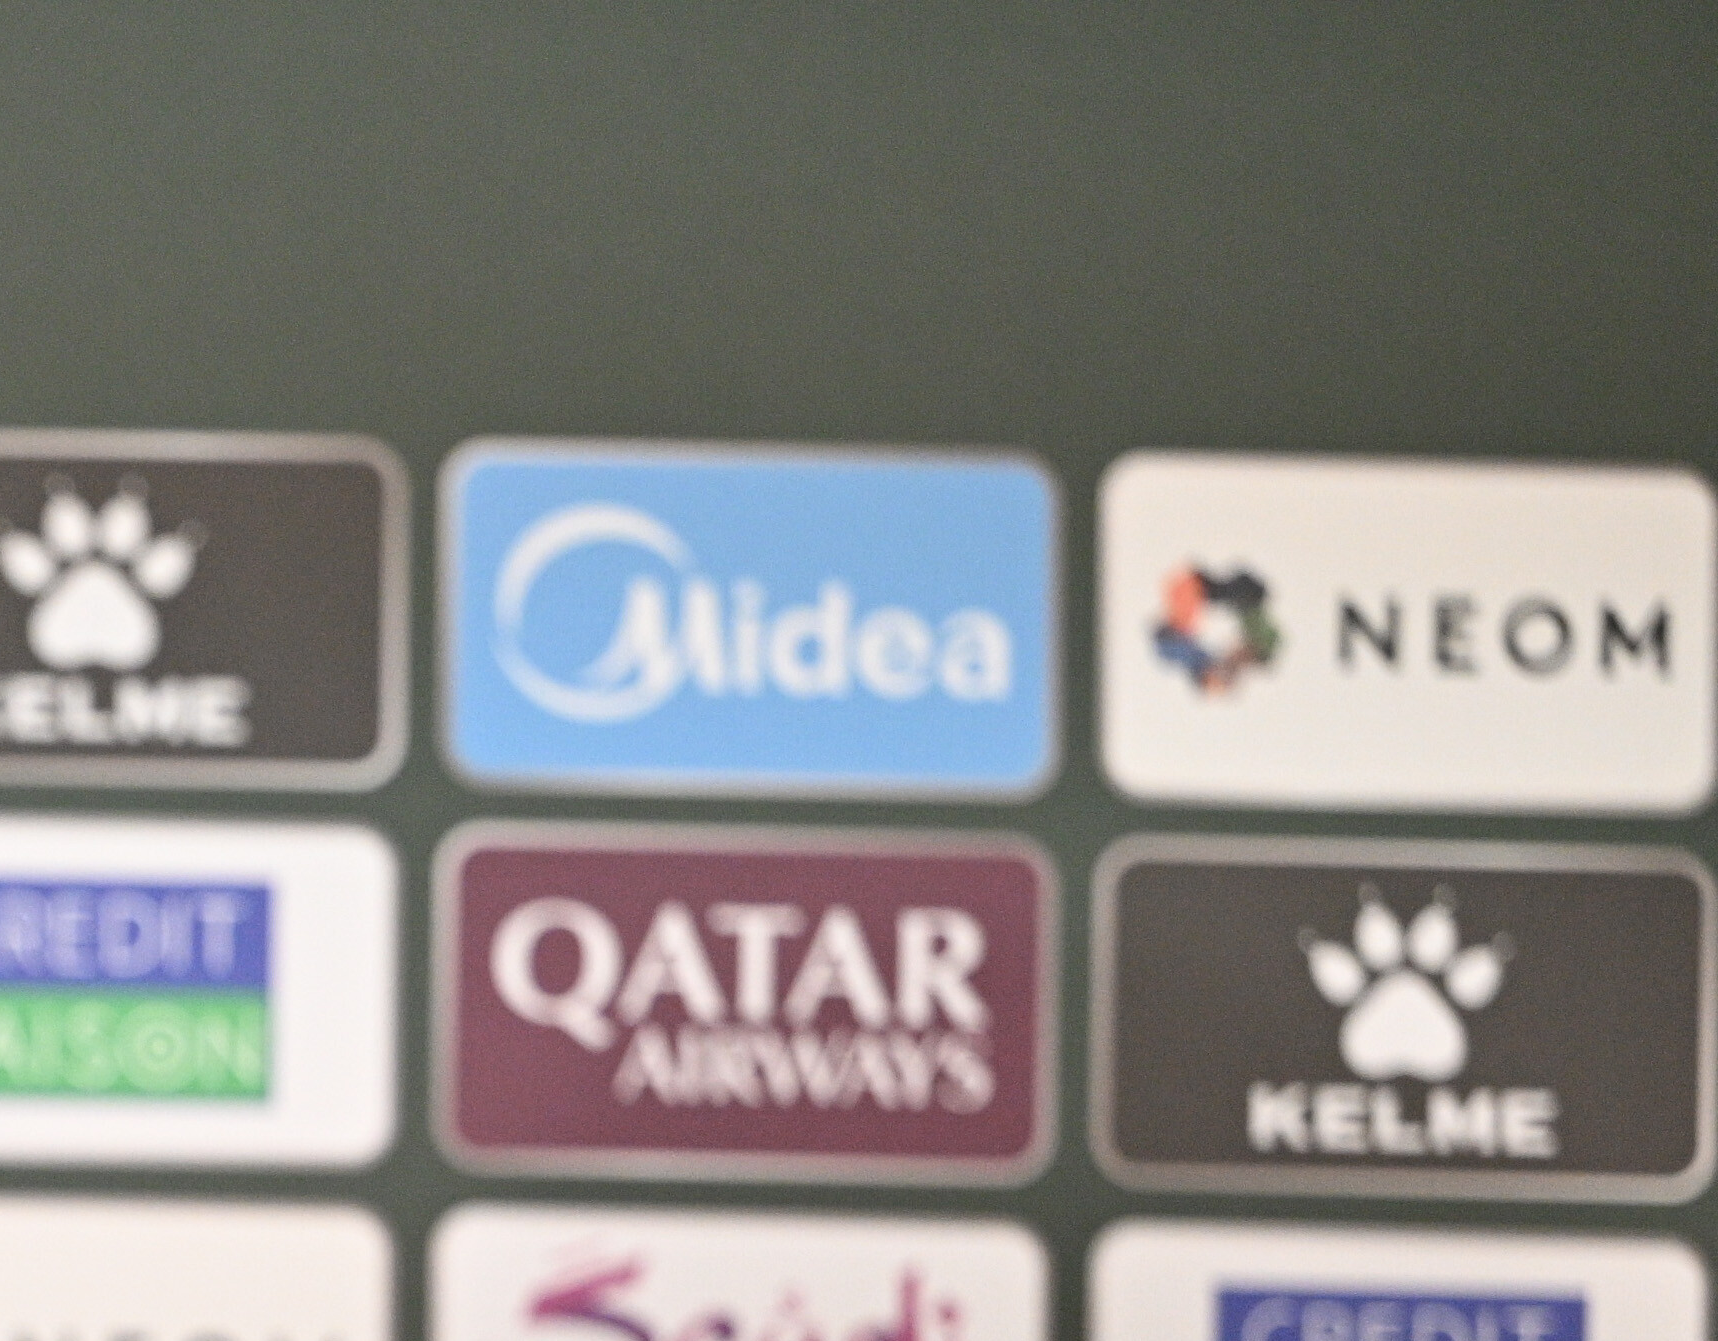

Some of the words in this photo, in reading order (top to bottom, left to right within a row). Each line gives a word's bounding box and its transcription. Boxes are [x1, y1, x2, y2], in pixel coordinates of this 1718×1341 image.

[585, 574, 1013, 702] Midea
[1336, 593, 1677, 679] NEOM
[491, 898, 988, 1050] QATAR
[615, 1028, 995, 1112] AIRWAYS
[1247, 1083, 1559, 1158] KELME
